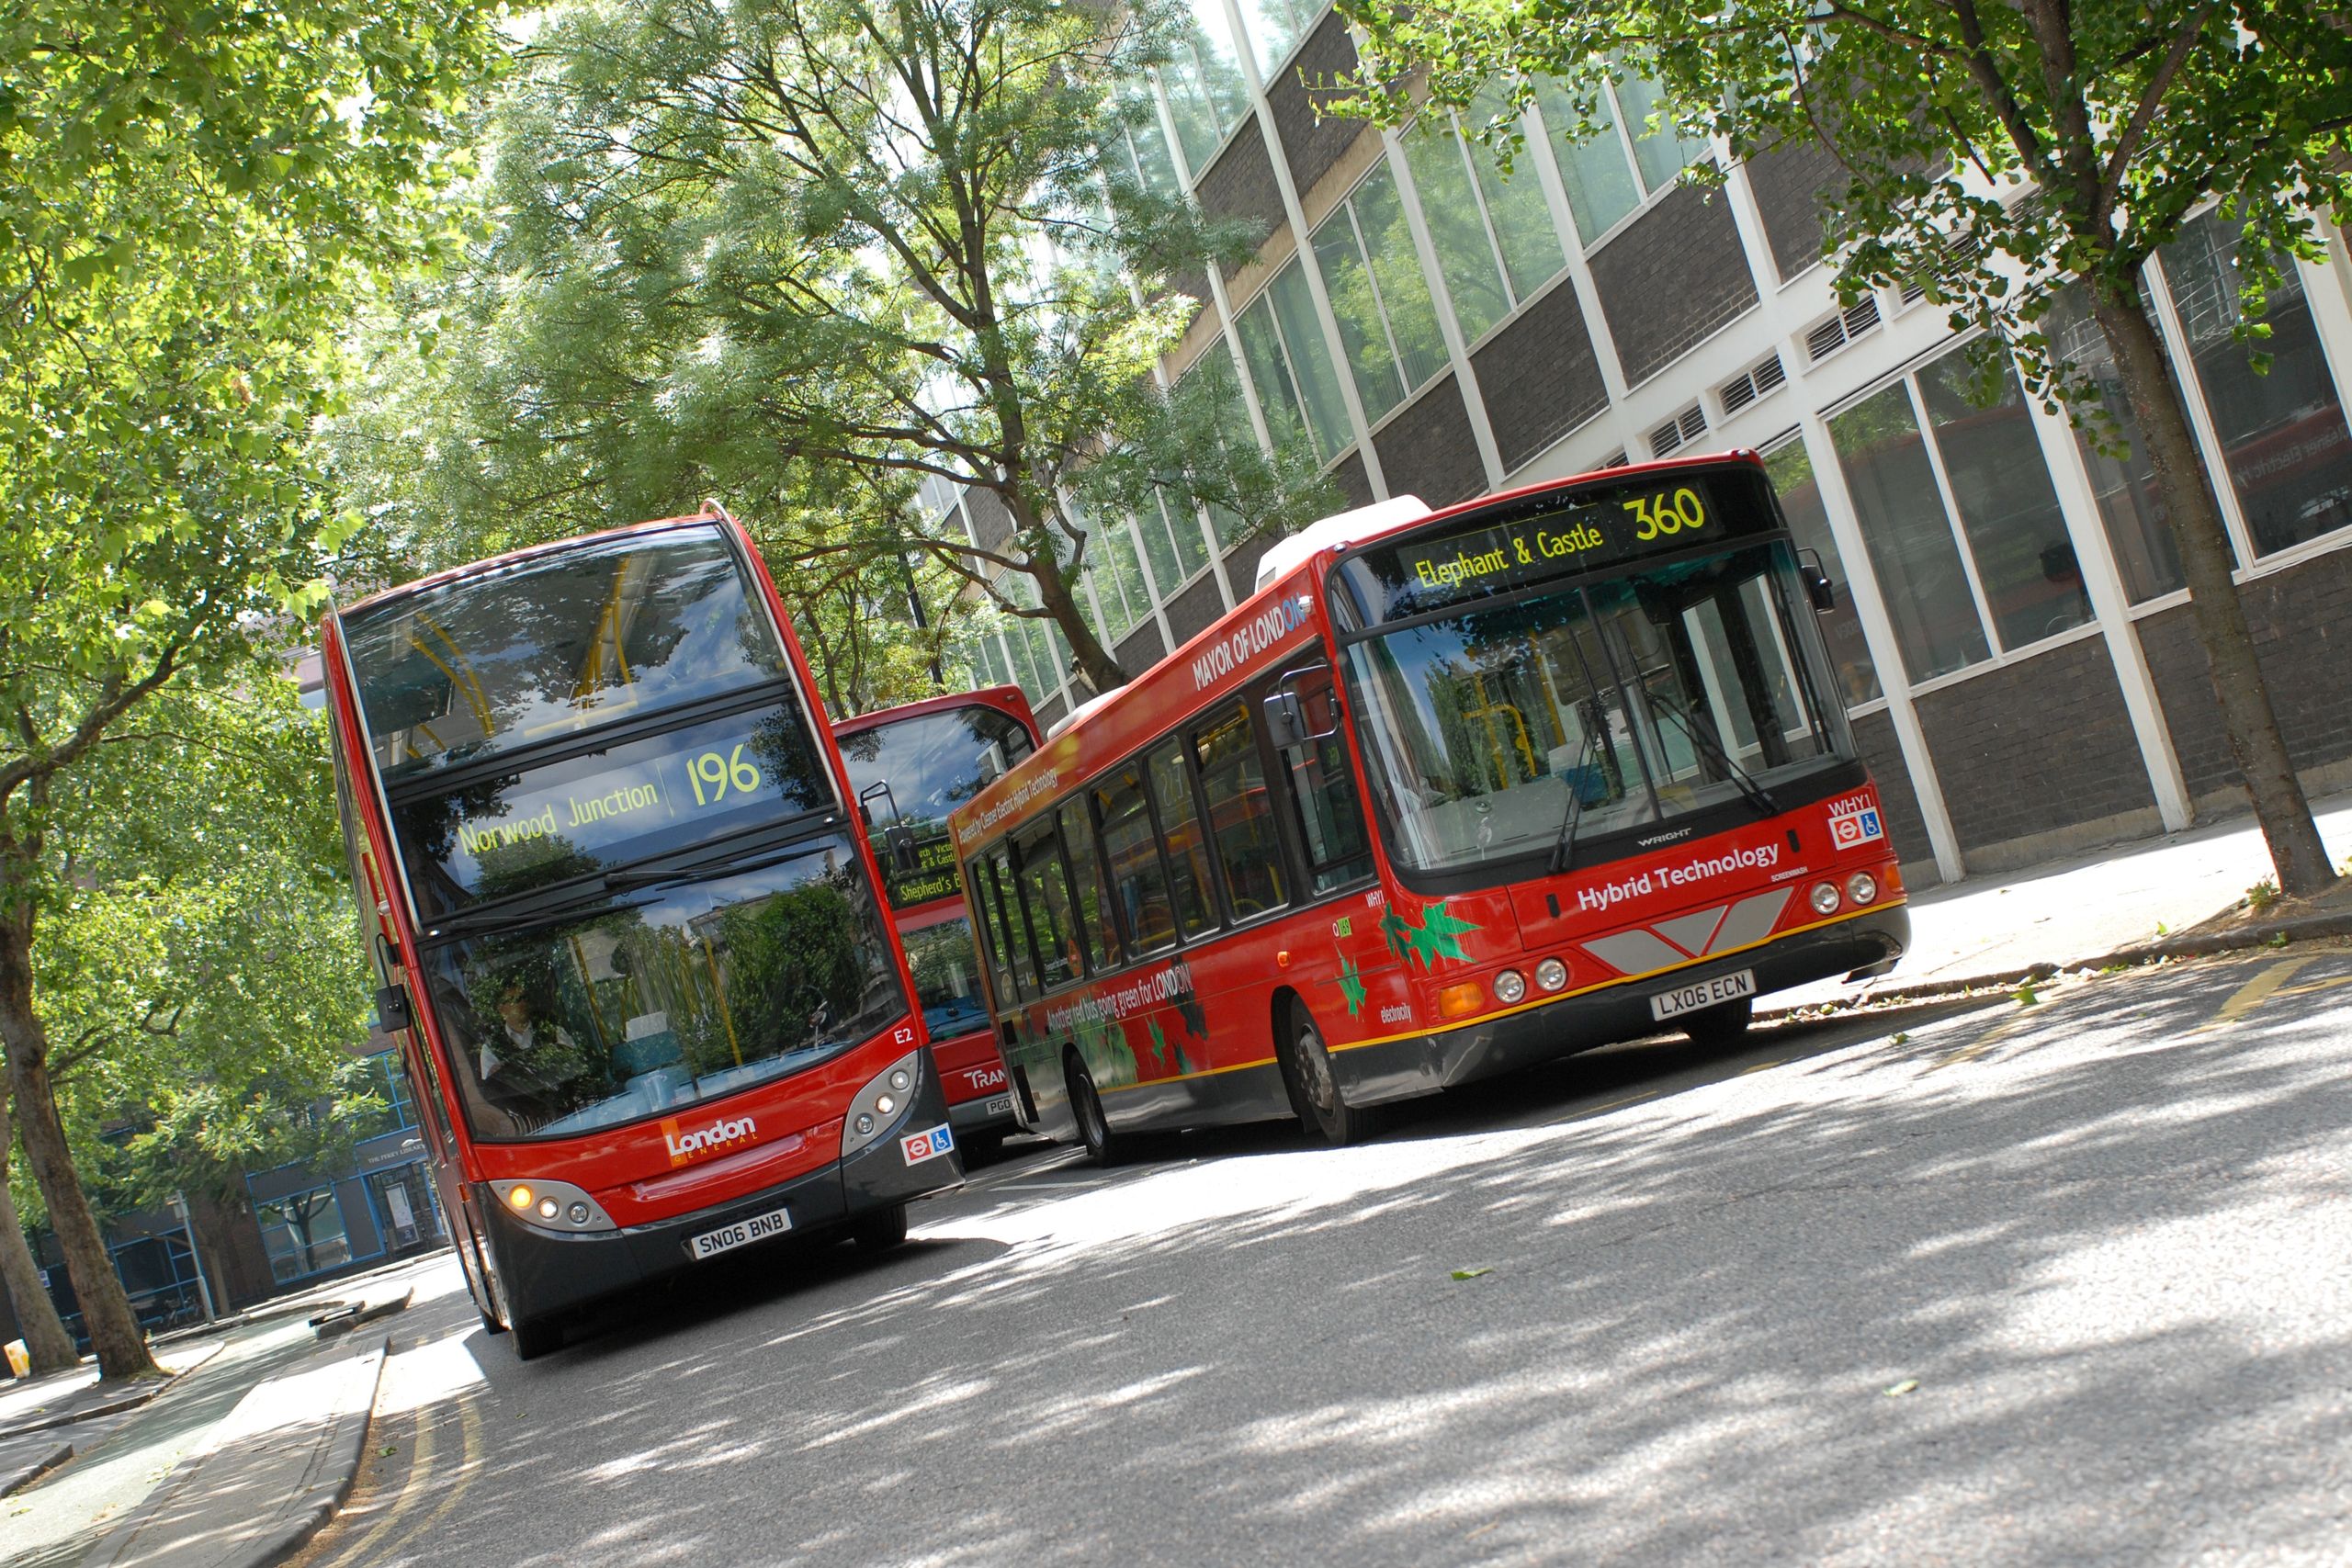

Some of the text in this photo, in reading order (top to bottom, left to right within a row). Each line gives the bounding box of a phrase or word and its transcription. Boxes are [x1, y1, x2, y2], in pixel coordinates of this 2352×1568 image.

[1623, 488, 1705, 541] 360
[1415, 524, 1603, 588] Elephant & Castle
[1193, 591, 1306, 692] MAYOR OF LONDON
[686, 742, 761, 807] 196
[995, 795, 1015, 820] Electric
[1012, 783, 1031, 811] Hybrid
[1027, 767, 1058, 798] Technology
[458, 783, 659, 856] Norwood Junction
[1827, 793, 1871, 818] WHY1
[1637, 828, 1691, 848] WRIGHT
[900, 875, 953, 901] Shepherd's
[1577, 843, 1779, 911] Hybrid Technology
[1365, 889, 1385, 908] WHY1
[1046, 963, 1194, 1032] Another red bus going green for LONDON
[1380, 1002, 1412, 1024] electrocity
[1658, 974, 1748, 1015] LX06 ECN
[894, 1028, 913, 1044] E2
[665, 1116, 756, 1156] London
[673, 1133, 758, 1163] GENERAL
[699, 1213, 784, 1254] SN06 BNB
